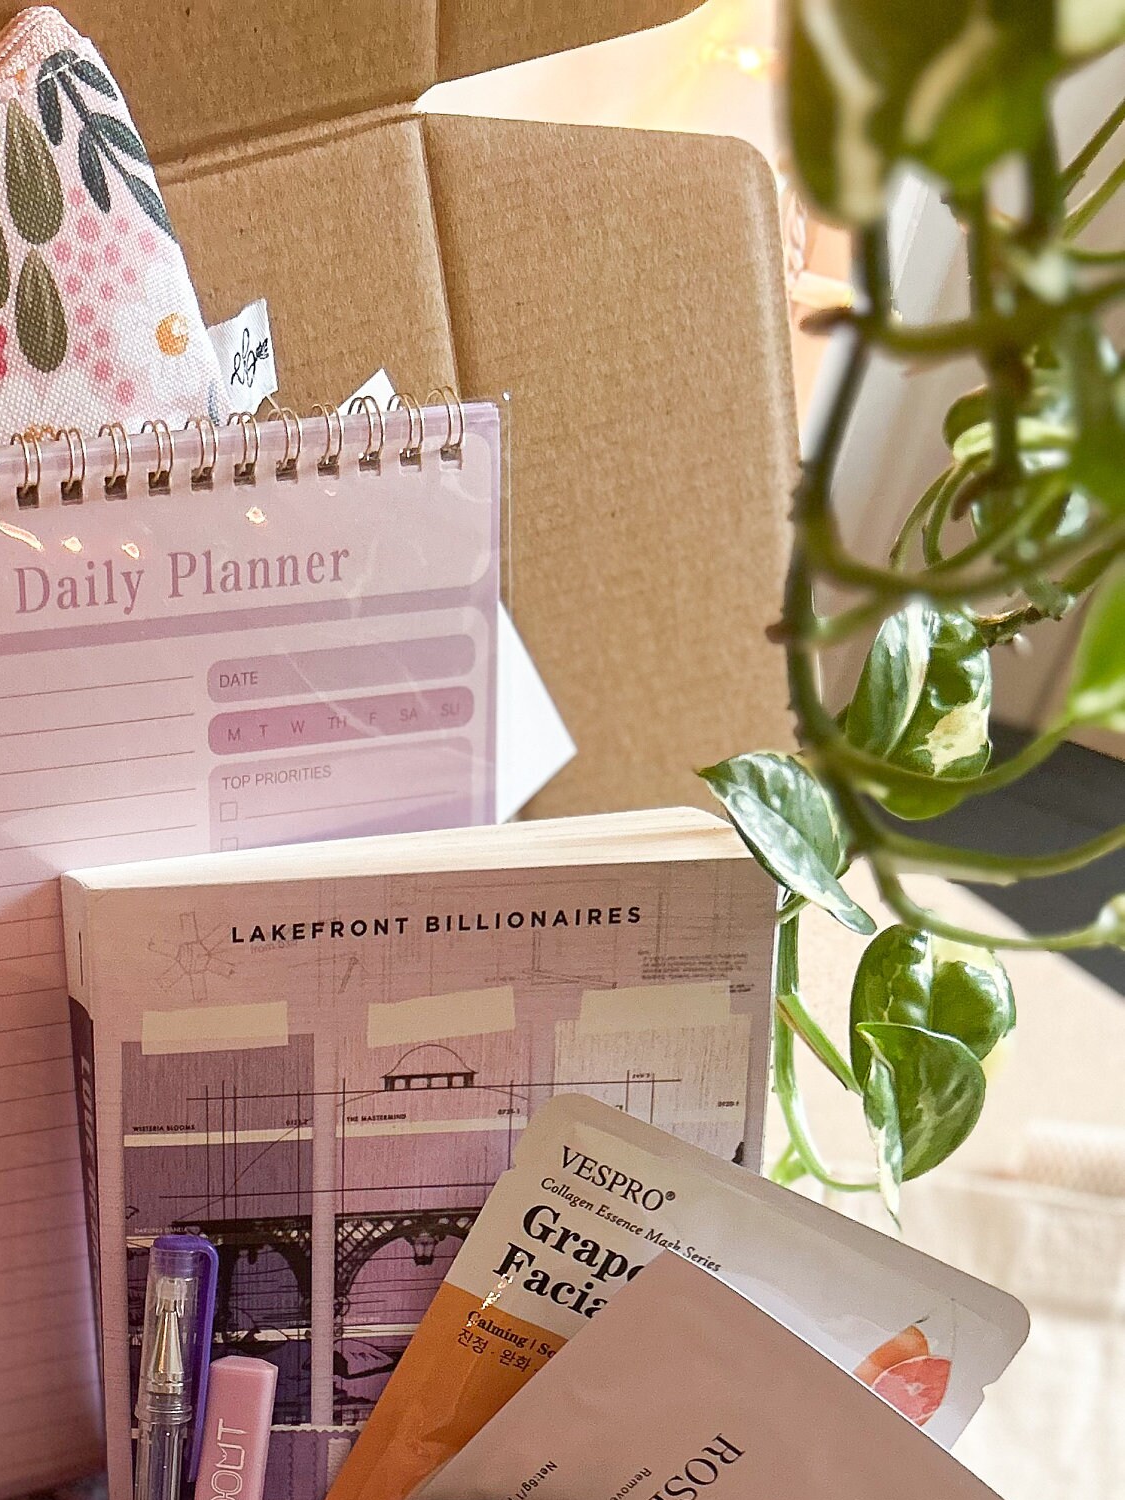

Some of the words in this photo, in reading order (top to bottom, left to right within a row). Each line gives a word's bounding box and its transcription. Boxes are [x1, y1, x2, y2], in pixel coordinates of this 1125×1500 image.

[14, 559, 144, 615] Daily
[167, 549, 350, 599] Planner
[219, 671, 259, 688] DATE
[227, 728, 241, 741] M
[259, 724, 269, 738] T
[291, 720, 305, 734] W
[327, 715, 347, 729] TH
[369, 712, 378, 725] F
[399, 708, 418, 722] SA
[440, 702, 460, 717] SU
[222, 775, 251, 790] TOP
[255, 765, 332, 786] PRIORITIES
[232, 917, 409, 943] LAKEFRONT
[426, 906, 641, 932] BILLIONAIRES
[541, 1177, 594, 1212] Collagen
[595, 1205, 643, 1235] Essence
[686, 1246, 722, 1273] Series
[467, 1310, 529, 1349] Calming
[457, 1328, 489, 1354] 진정
[499, 1349, 532, 1372] 완화
